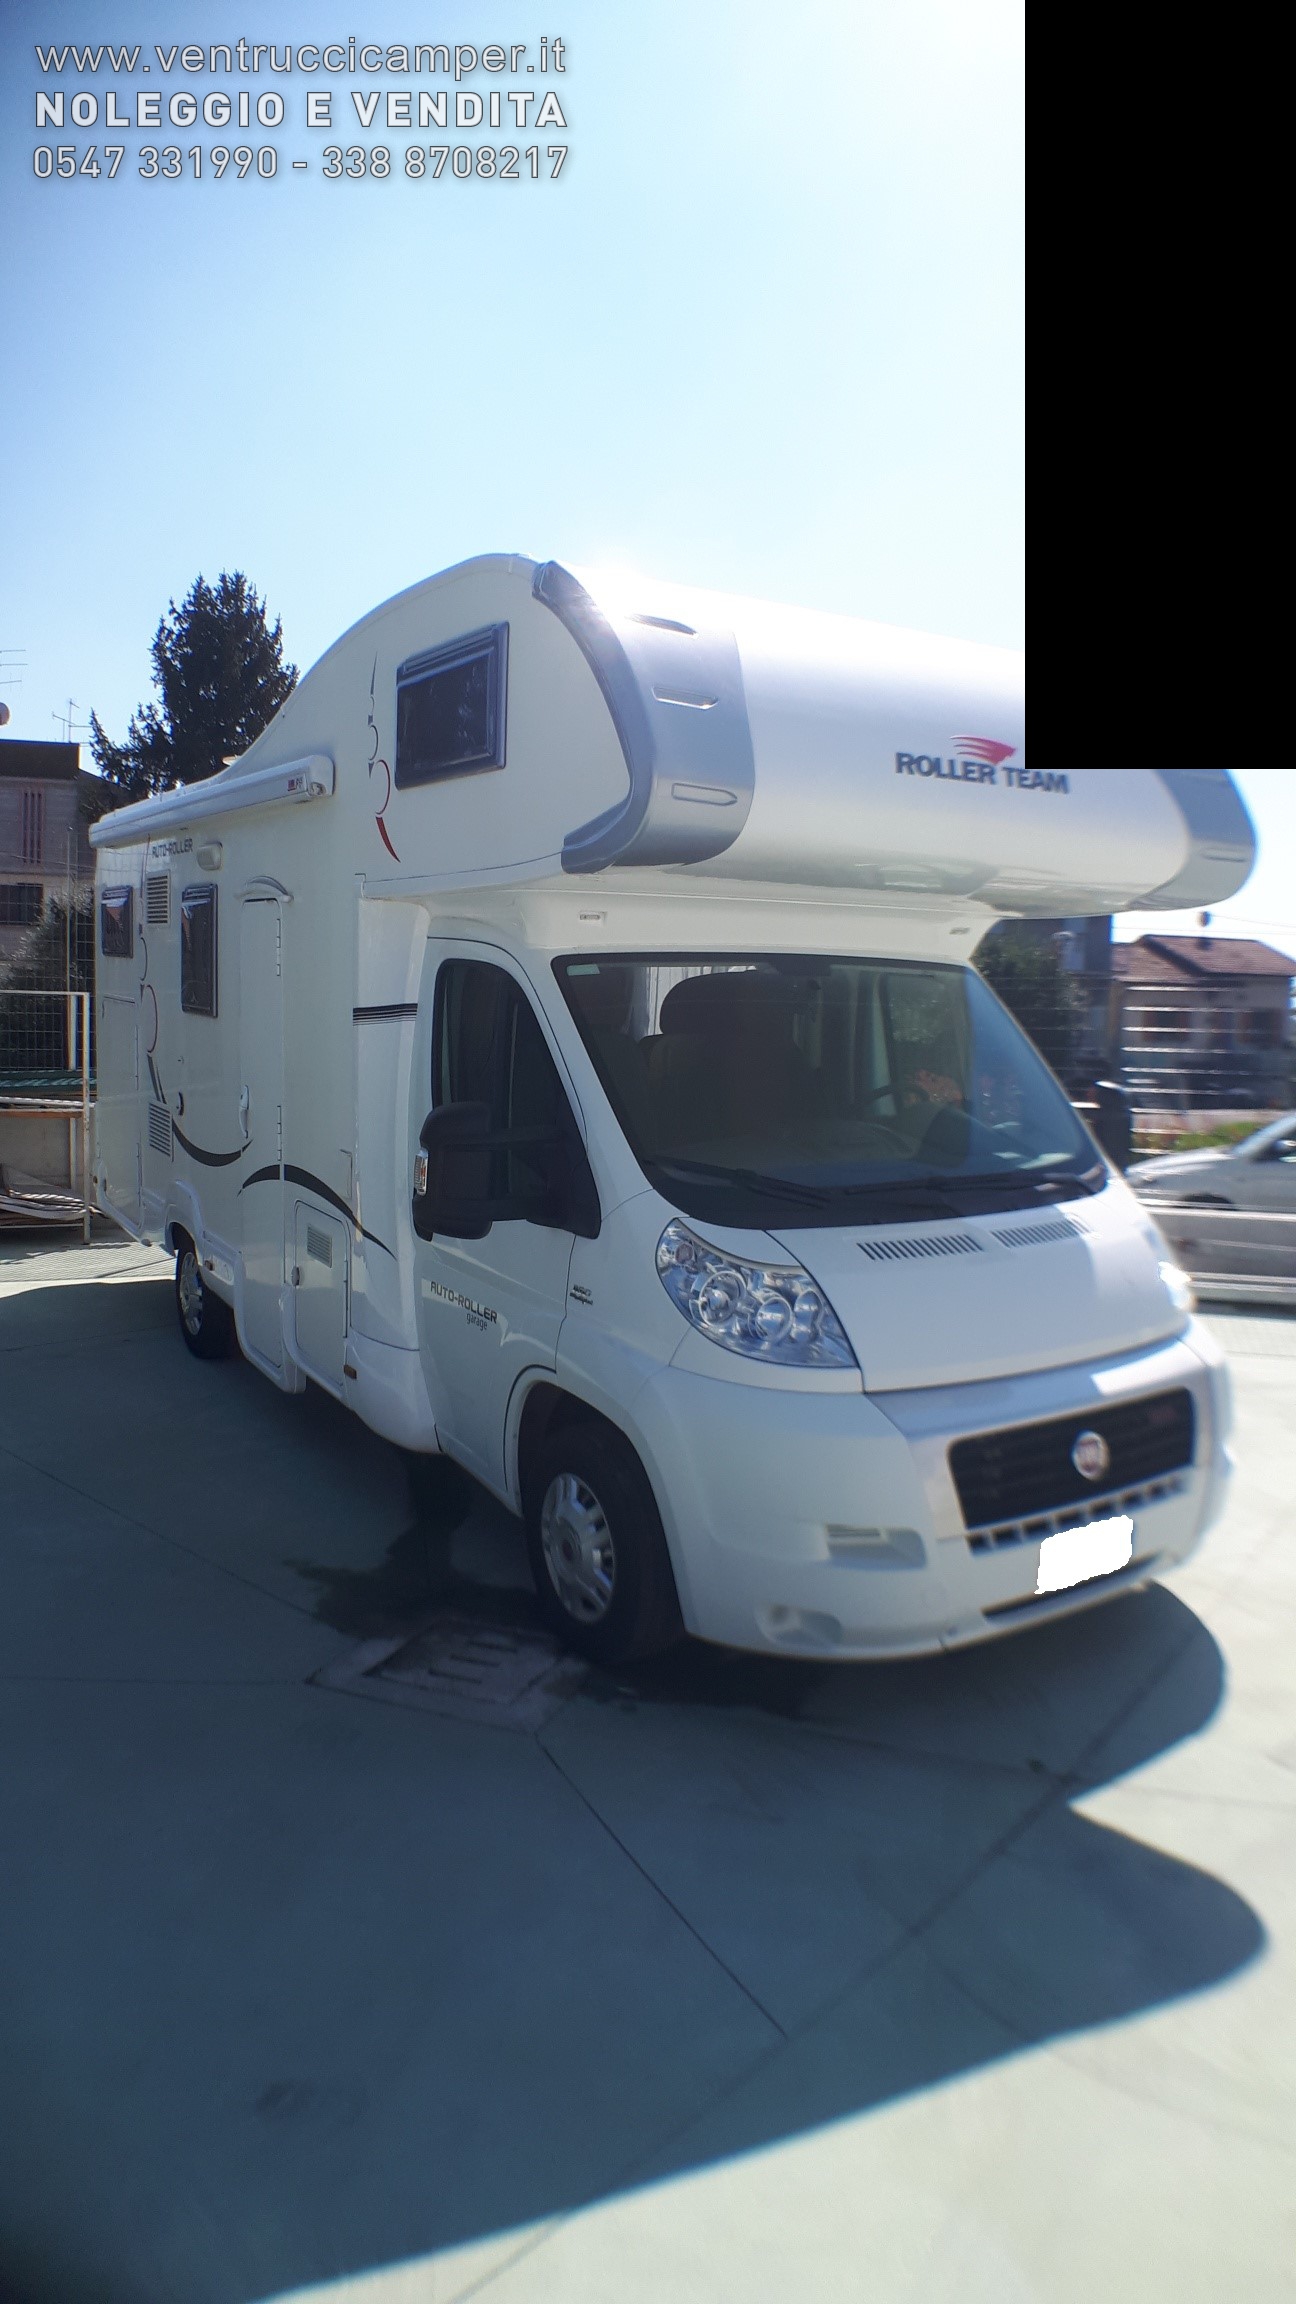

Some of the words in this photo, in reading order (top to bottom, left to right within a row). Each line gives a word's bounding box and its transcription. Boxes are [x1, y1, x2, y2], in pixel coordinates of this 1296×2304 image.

[895, 752, 996, 785] ROLLER
[1003, 766, 1070, 794] TEAM
[430, 1281, 498, 1324] AUTO-ROLLER
[466, 1312, 488, 1331] garage
